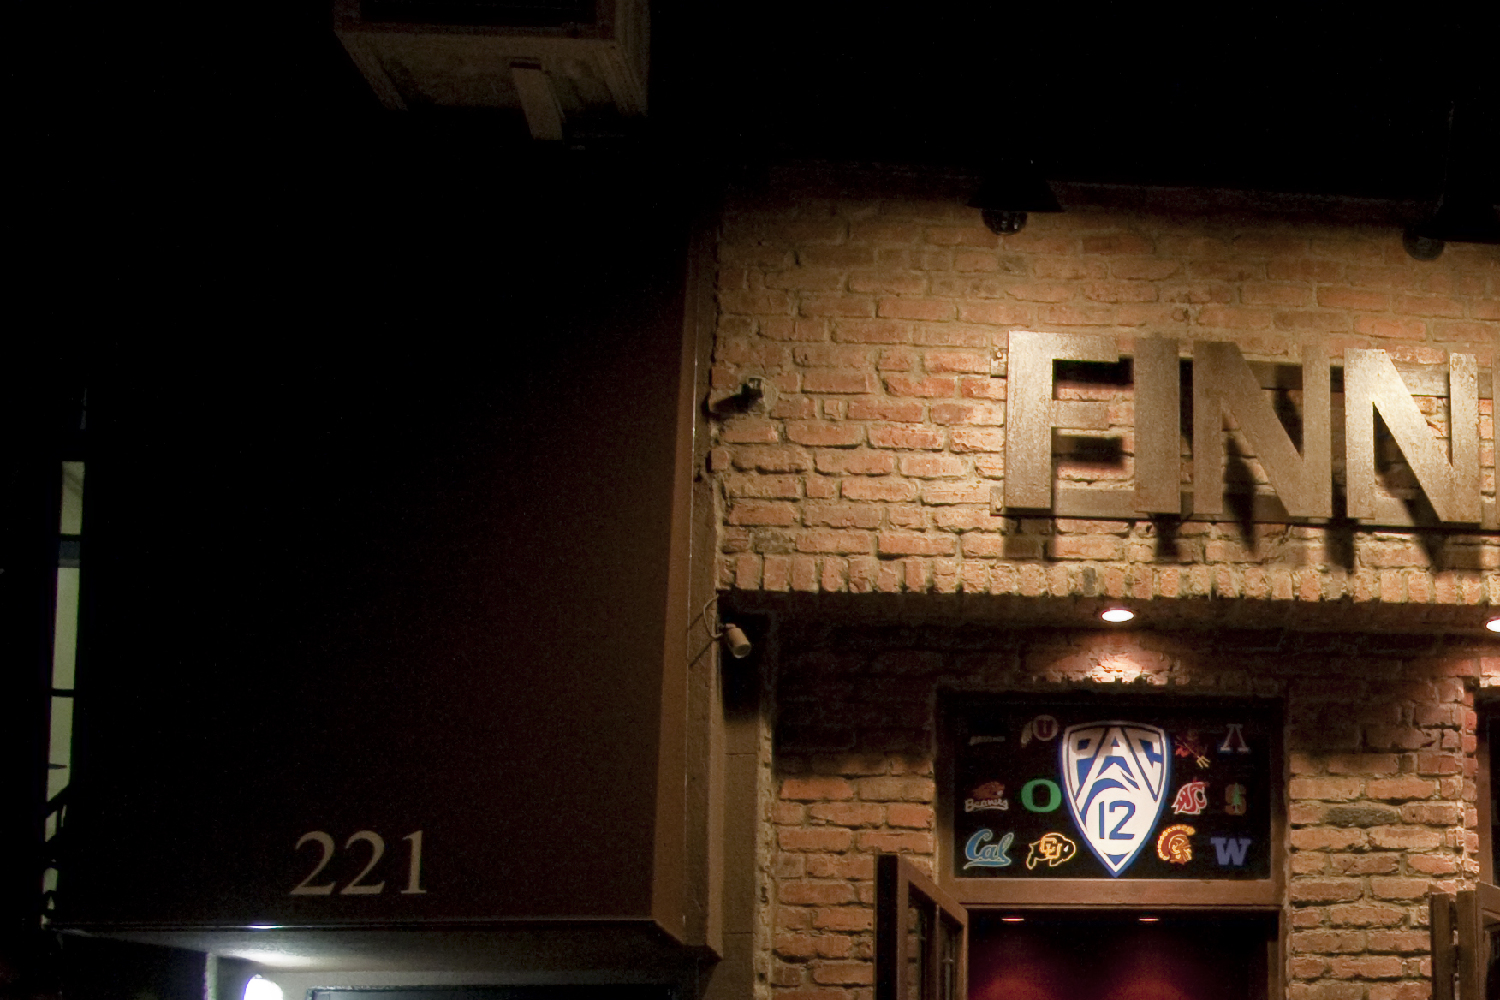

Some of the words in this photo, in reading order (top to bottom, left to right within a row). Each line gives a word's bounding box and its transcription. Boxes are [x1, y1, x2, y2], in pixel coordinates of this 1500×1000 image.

[1098, 799, 1136, 841] 12
[289, 829, 428, 897] 221
[963, 828, 1015, 869] Cal
[1211, 836, 1252, 866] W
